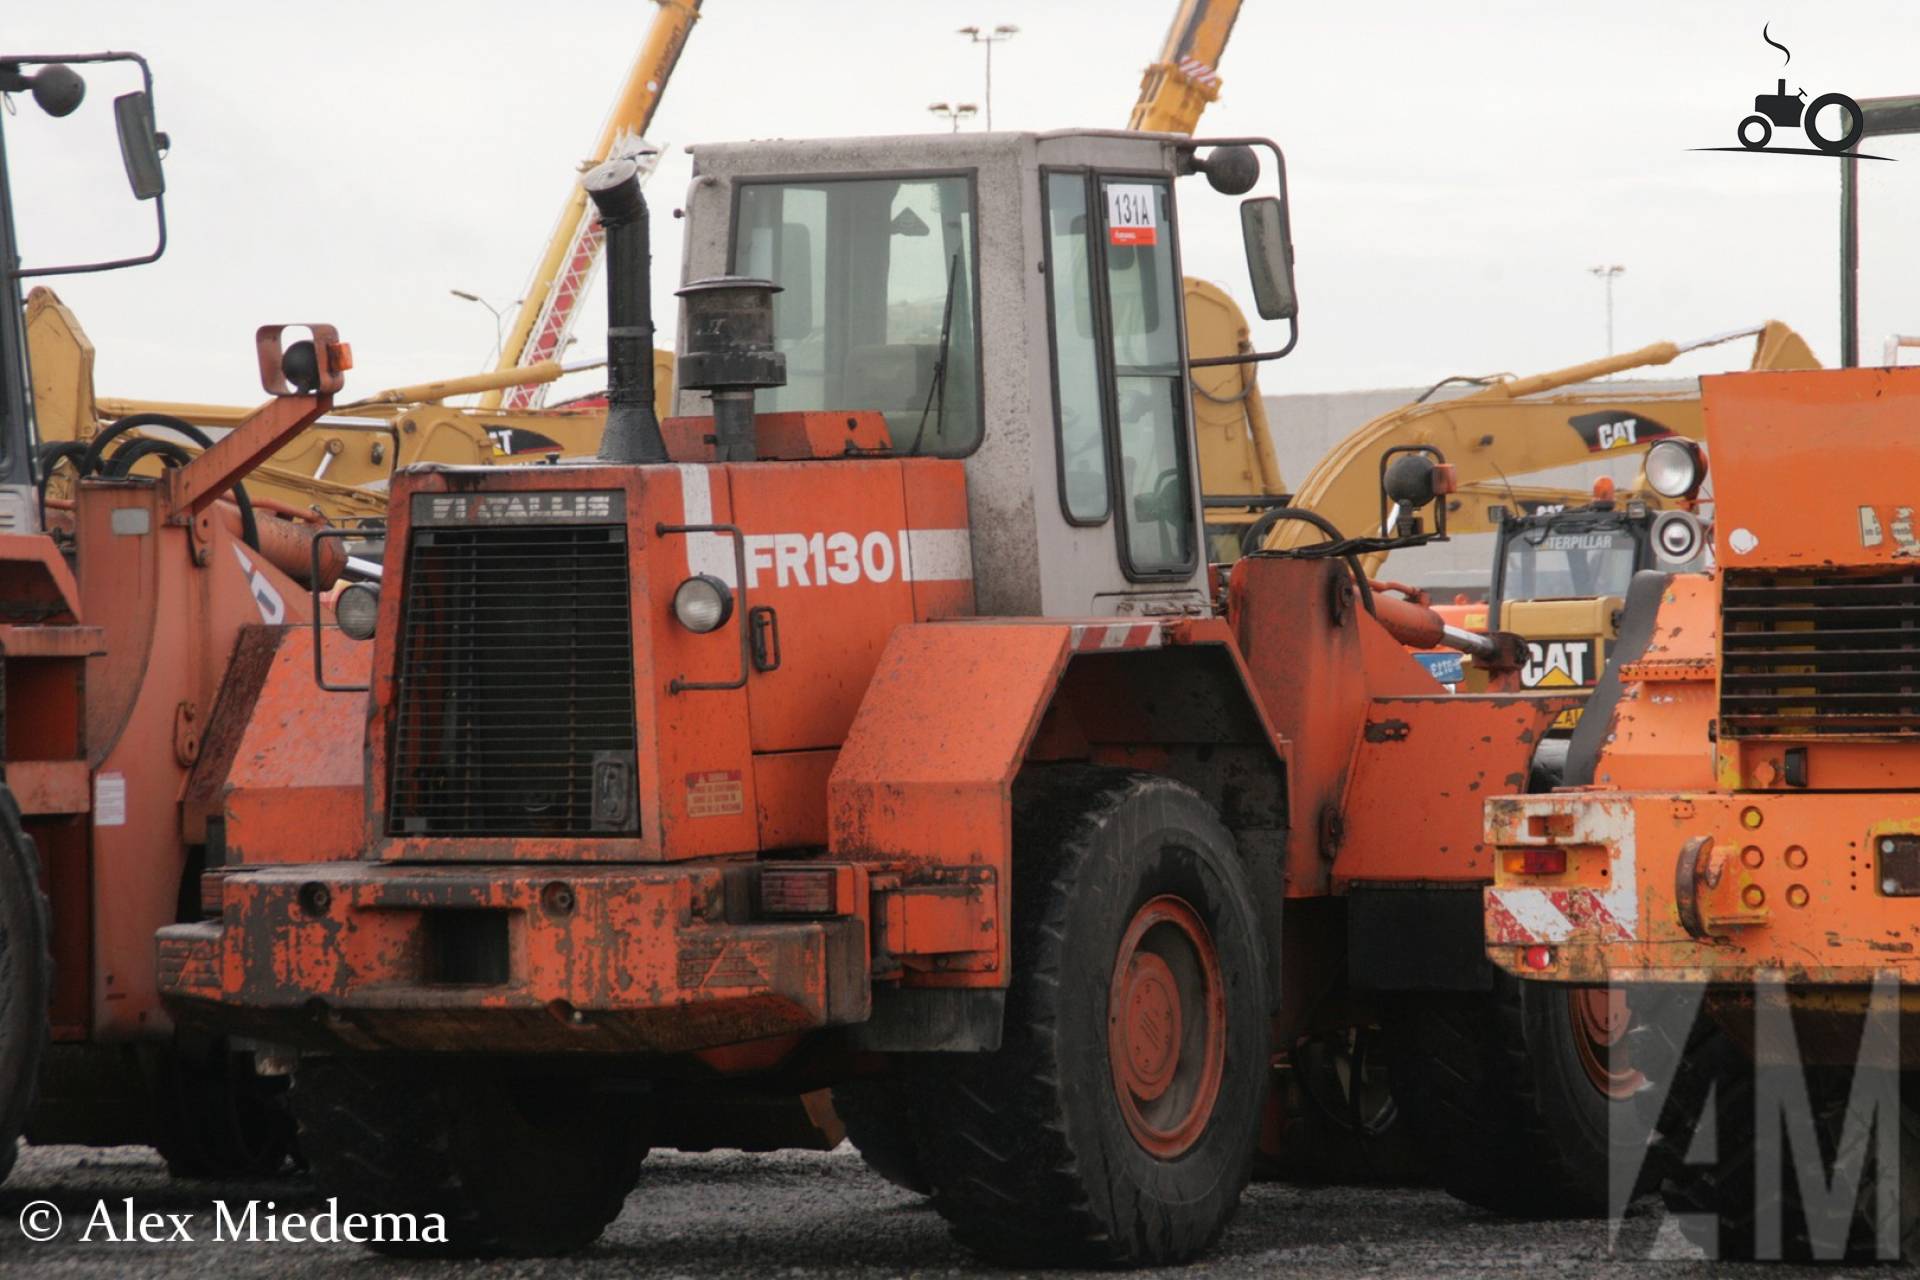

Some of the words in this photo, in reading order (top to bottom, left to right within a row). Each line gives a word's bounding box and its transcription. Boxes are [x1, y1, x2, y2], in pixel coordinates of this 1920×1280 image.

[1115, 193, 1150, 225] 131A
[1598, 419, 1636, 450] CAT
[433, 496, 610, 519] FIATALLIS
[745, 531, 895, 588] FR130
[1521, 642, 1588, 688] CAT
